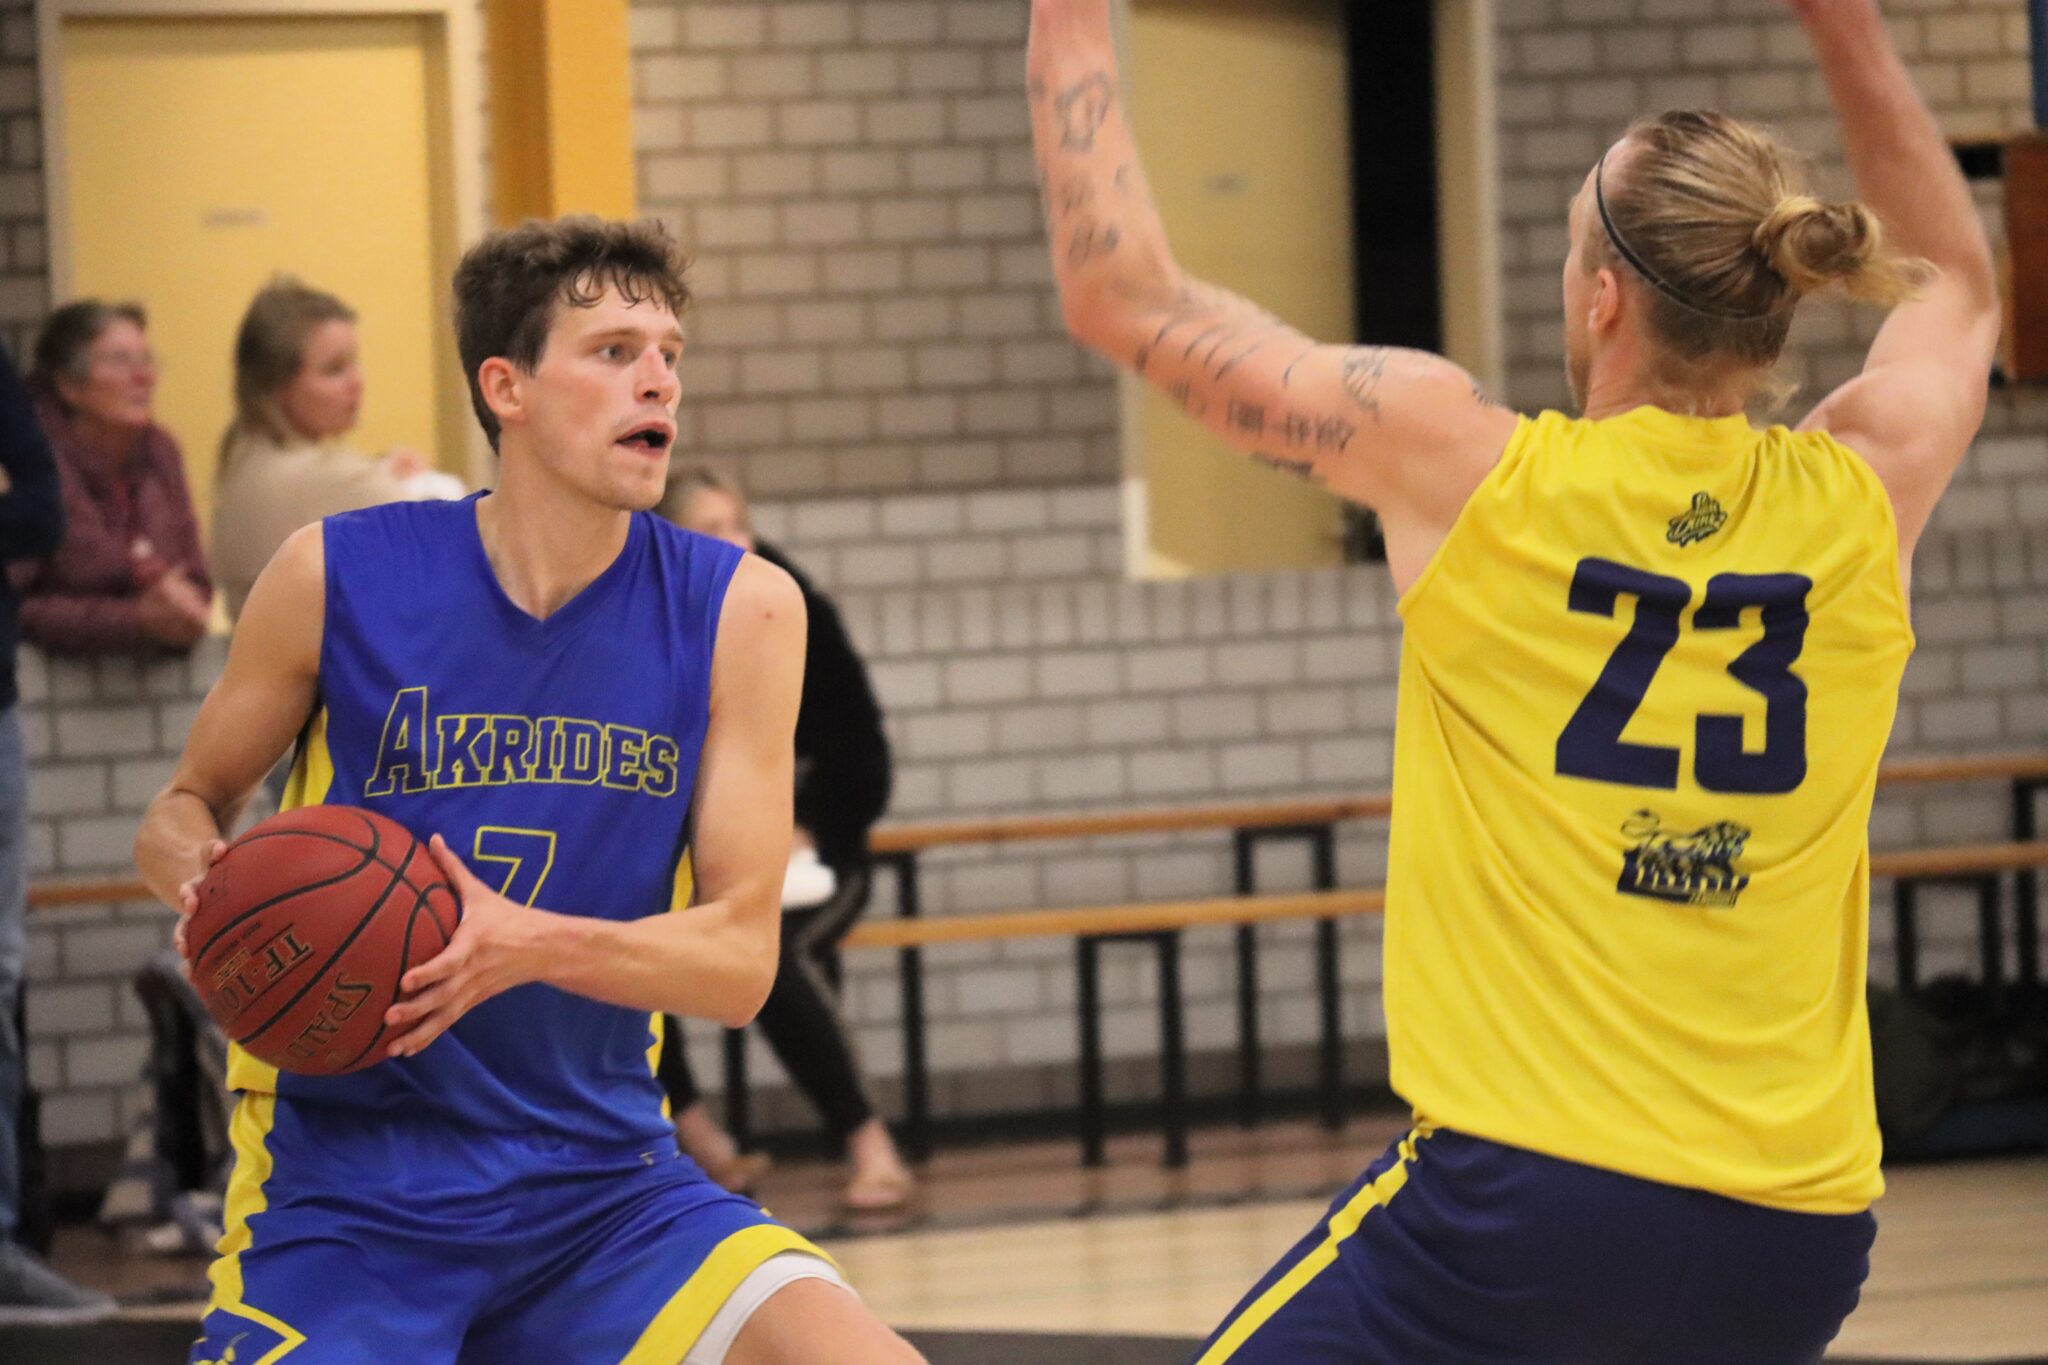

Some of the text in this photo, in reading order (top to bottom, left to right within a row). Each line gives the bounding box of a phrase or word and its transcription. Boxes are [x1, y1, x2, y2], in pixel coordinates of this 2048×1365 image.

[1555, 556, 1813, 795] 23
[364, 686, 679, 797] AKRIDES
[474, 825, 557, 909] 7
